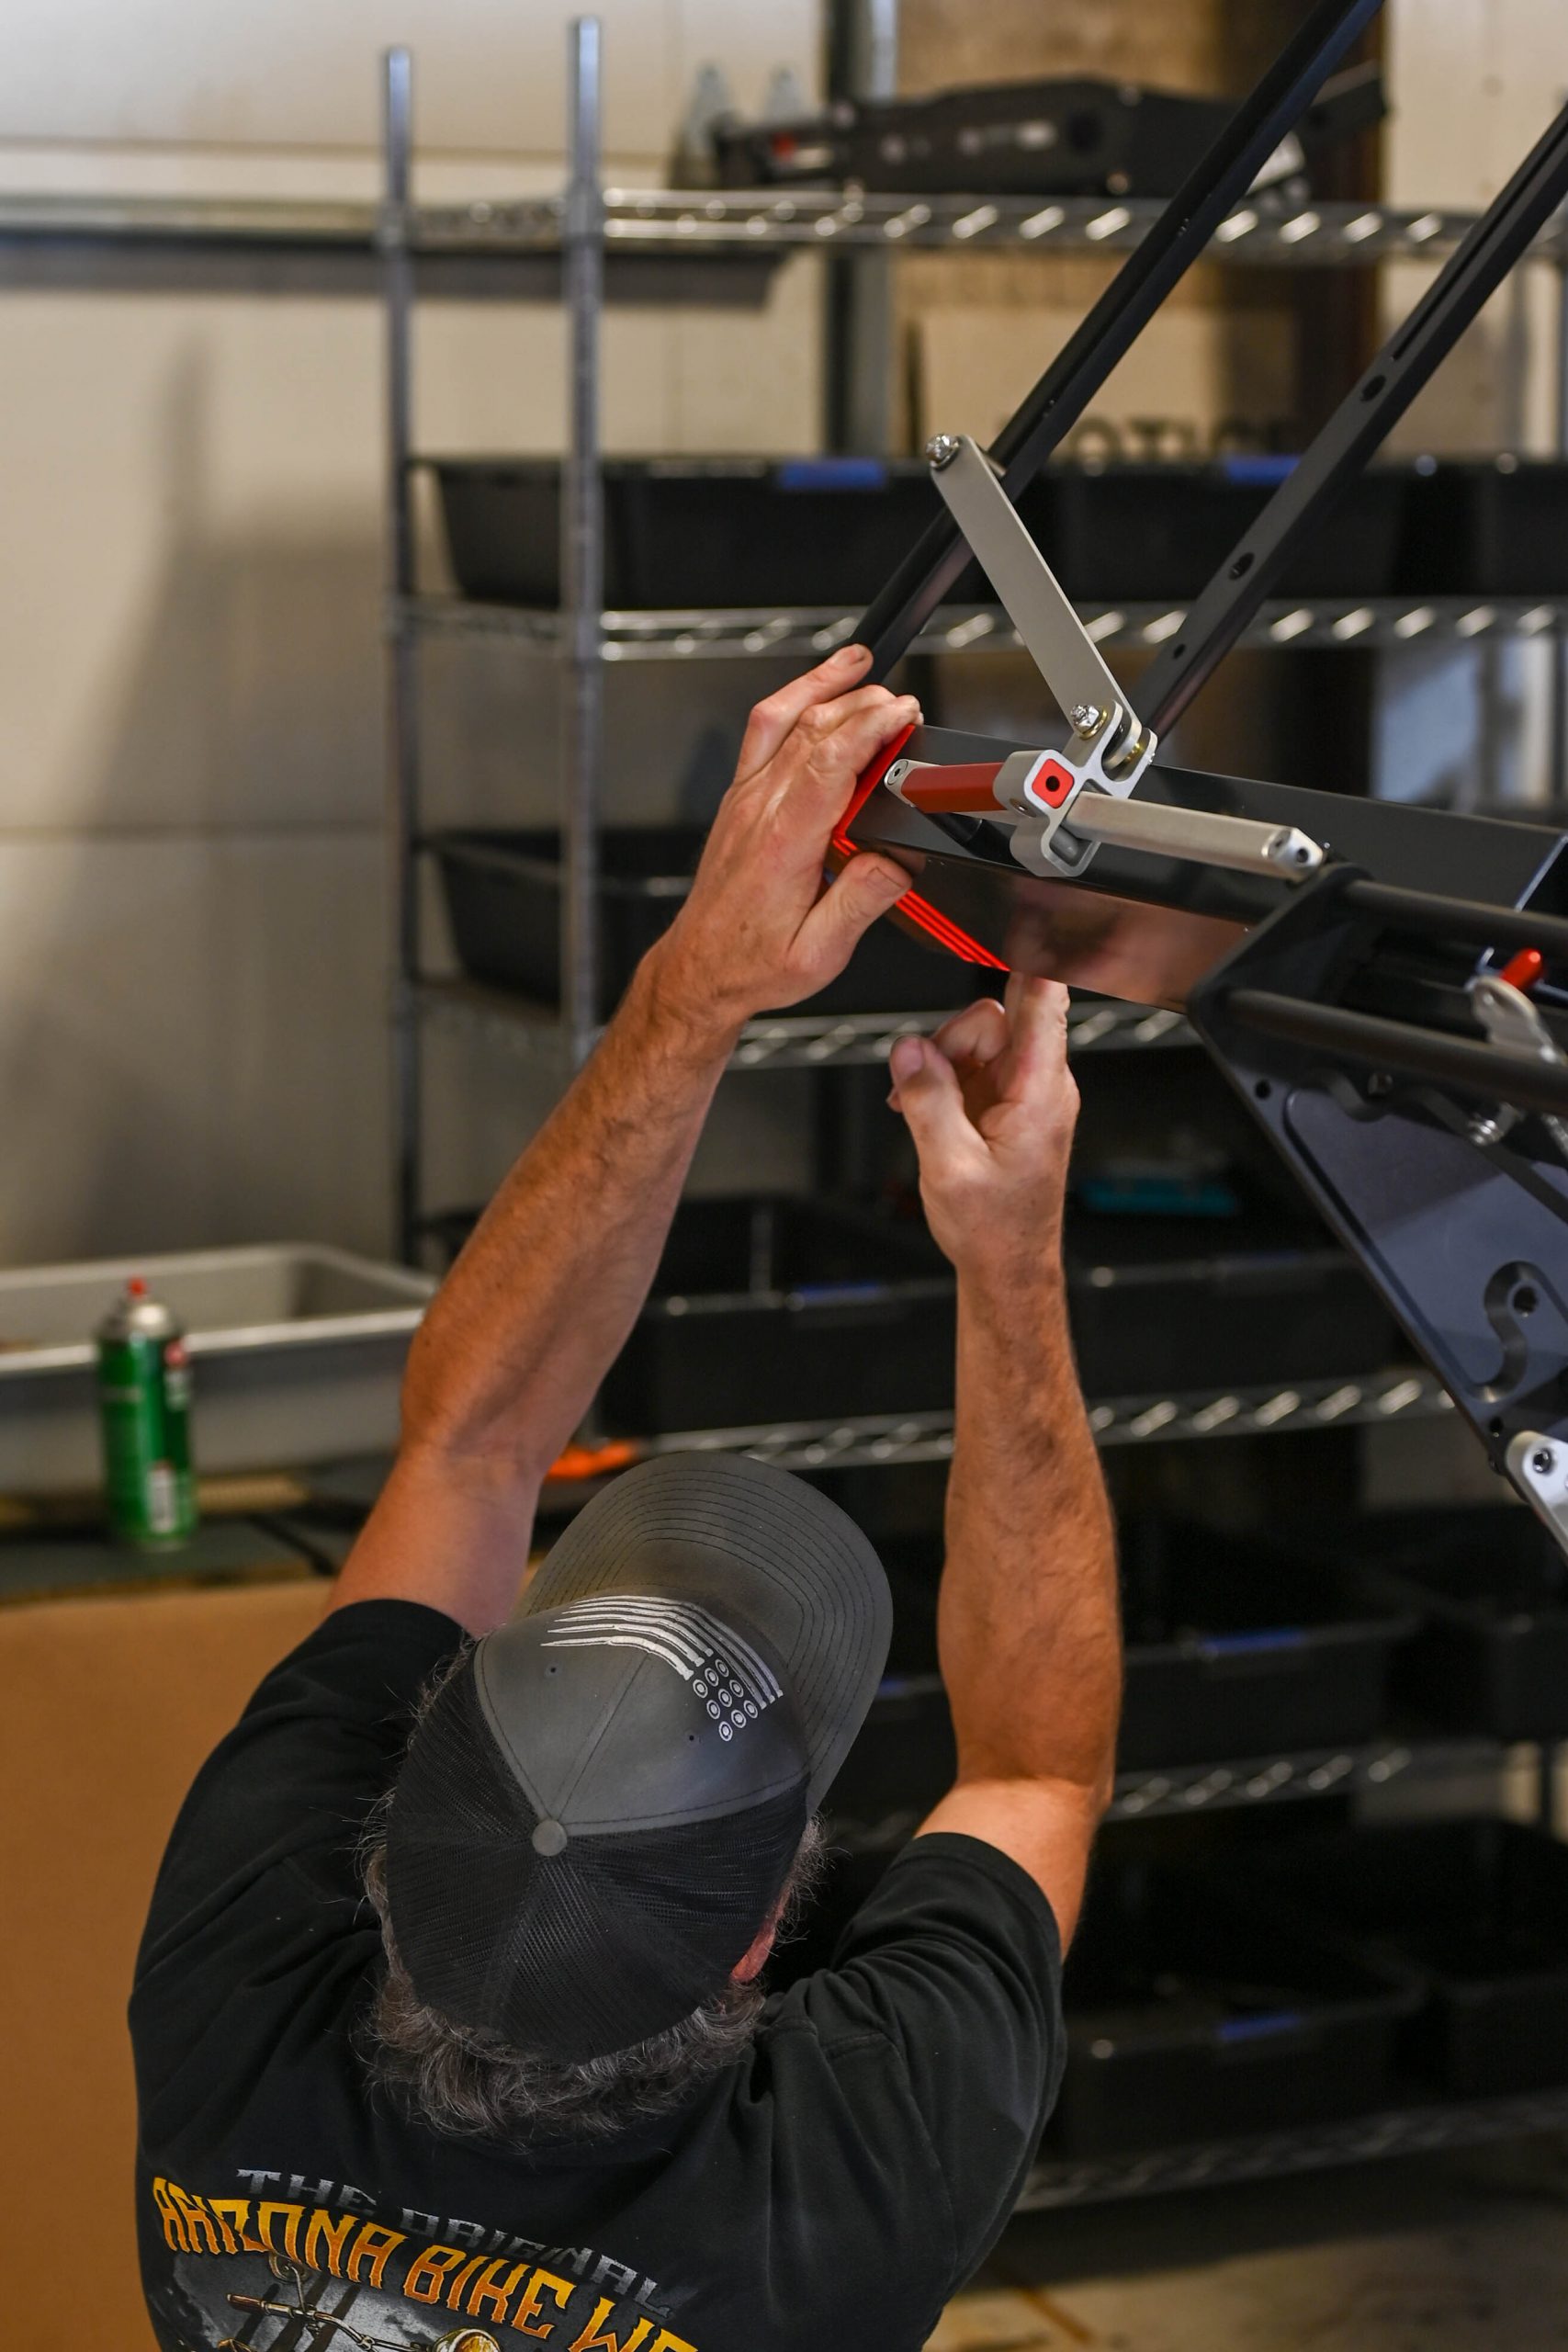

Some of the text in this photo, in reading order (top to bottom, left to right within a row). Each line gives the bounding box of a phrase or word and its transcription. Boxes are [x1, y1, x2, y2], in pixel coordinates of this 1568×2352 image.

[152, 2177, 410, 2289] ARIZONA
[402, 2245, 578, 2339] BIKE
[236, 2168, 674, 2318] THE ORIGINAL
